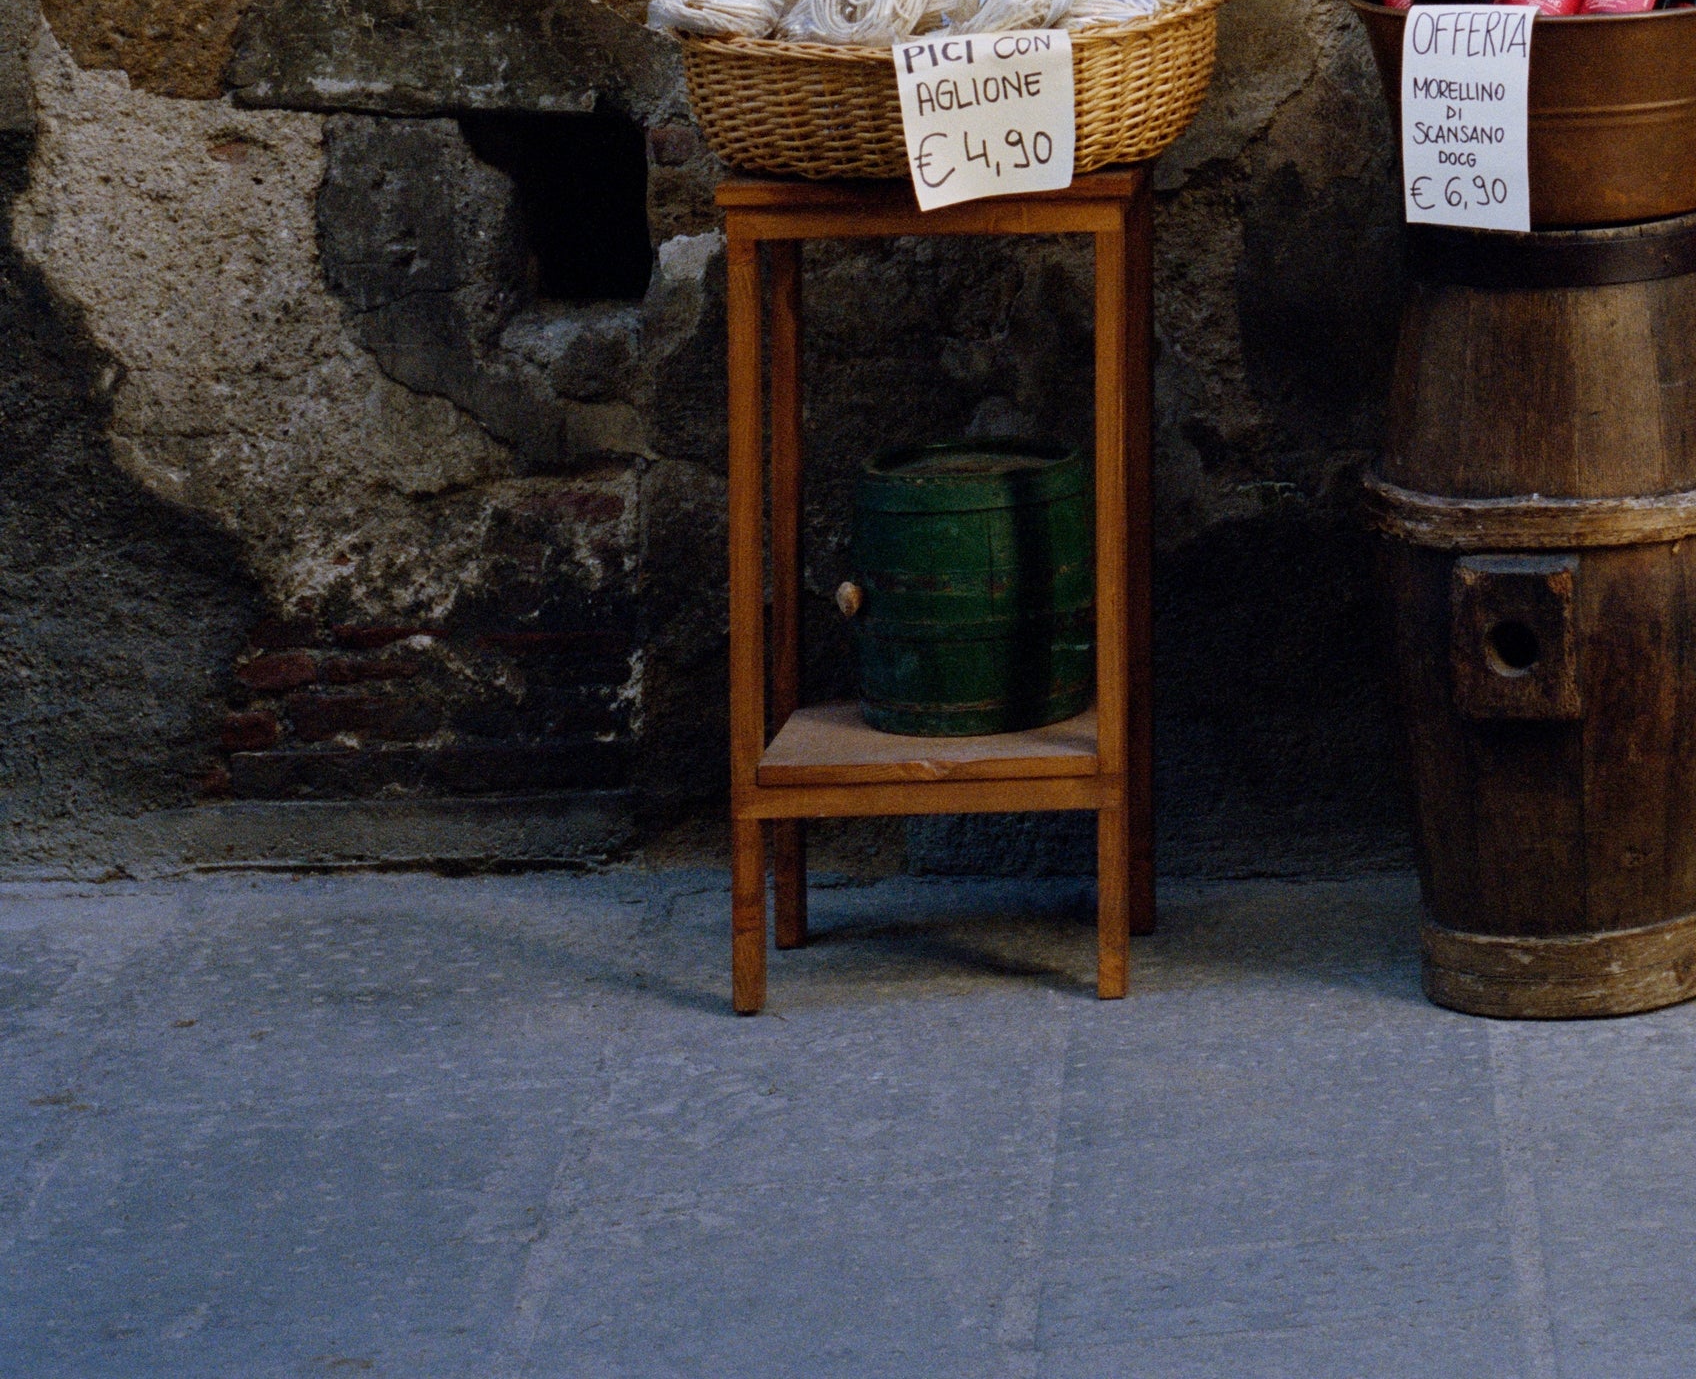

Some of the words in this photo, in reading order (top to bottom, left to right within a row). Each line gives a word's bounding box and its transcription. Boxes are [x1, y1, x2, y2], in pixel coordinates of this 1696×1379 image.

[1412, 11, 1526, 59] OFFERTA
[903, 42, 974, 73] PICI
[992, 35, 1051, 61] CON
[916, 72, 1043, 116] AGLIONE
[1413, 77, 1505, 101] MORELLINO
[1446, 105, 1462, 121] DI
[1413, 122, 1505, 145] SCANSANO
[914, 133, 956, 188] €
[965, 129, 1052, 177] 4,90
[1438, 151, 1477, 168] DOCG
[1410, 177, 1435, 210] €
[1444, 177, 1508, 211] 6,90
